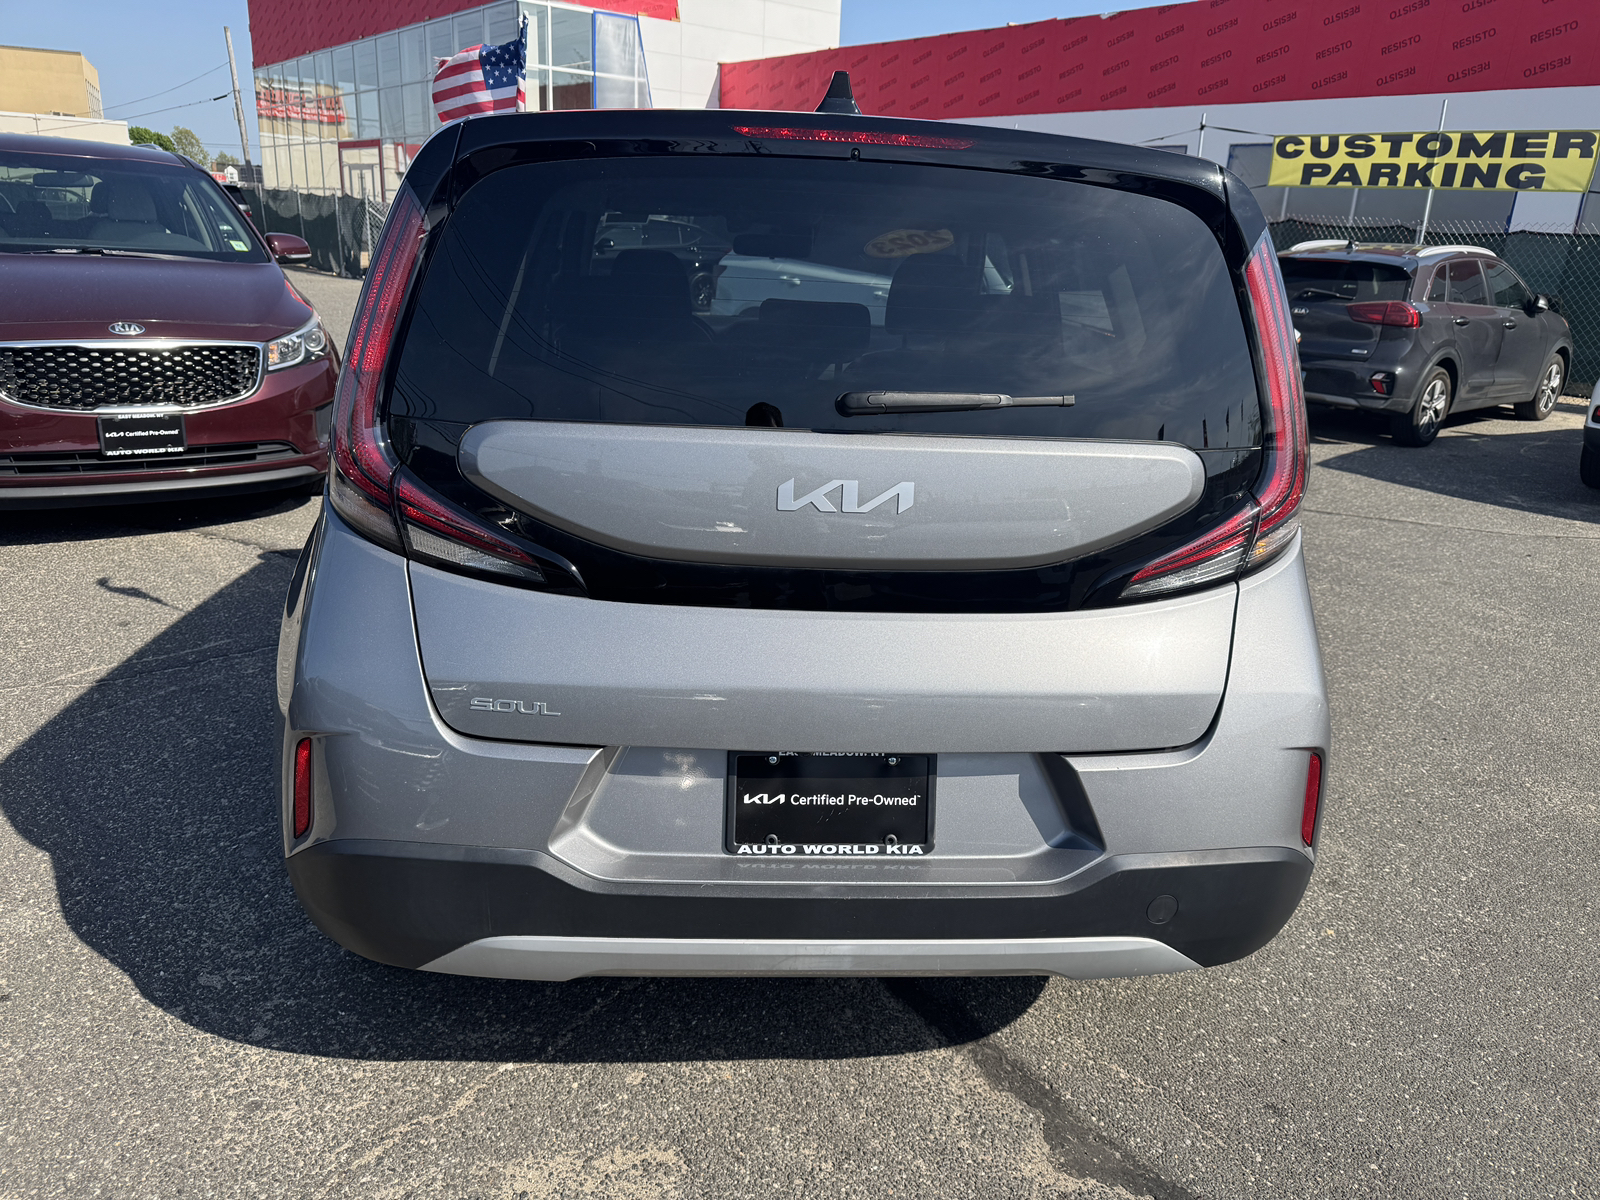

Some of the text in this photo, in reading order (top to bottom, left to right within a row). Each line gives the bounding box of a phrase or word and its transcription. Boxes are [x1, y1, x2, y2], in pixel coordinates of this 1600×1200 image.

[1323, 4, 1361, 26] RESISTO
[1389, 0, 1431, 20] RESISTO
[1206, 18, 1239, 36] RESISTO
[1262, 11, 1297, 32] RESISTO
[1107, 29, 1134, 48] RESISTO
[1154, 24, 1185, 42] RESISTO
[1452, 27, 1497, 51] RESISTO
[1530, 20, 1579, 44] RESISTO
[1062, 34, 1088, 52] RESISTO
[1315, 40, 1352, 60] RESISTO
[1380, 34, 1422, 56] RESISTO
[1200, 50, 1232, 68] RESISTO
[1256, 44, 1290, 64] RESISTO
[1018, 65, 1042, 81] RESISTO
[1058, 63, 1084, 80] RESISTO
[1102, 60, 1130, 77] RESISTO
[1150, 55, 1180, 73] RESISTO
[1446, 61, 1491, 82] RESISTO
[1523, 55, 1572, 78] RESISTO
[980, 68, 1002, 84] RESISTO
[1252, 74, 1286, 93] RESISTO
[1311, 70, 1348, 90] RESISTO
[1376, 66, 1416, 87] RESISTO
[1056, 88, 1082, 104] RESISTO
[1100, 85, 1128, 102] RESISTO
[1147, 82, 1176, 100] RESISTO
[1197, 78, 1229, 96] RESISTO
[1276, 131, 1594, 159] CUSTOMER
[1300, 162, 1547, 189] PARKING
[777, 477, 915, 515] KIA
[470, 697, 561, 717] SOUL
[744, 793, 786, 804] KIA
[790, 794, 844, 806] Certified
[737, 844, 924, 854] AUTO WORLD KIA
